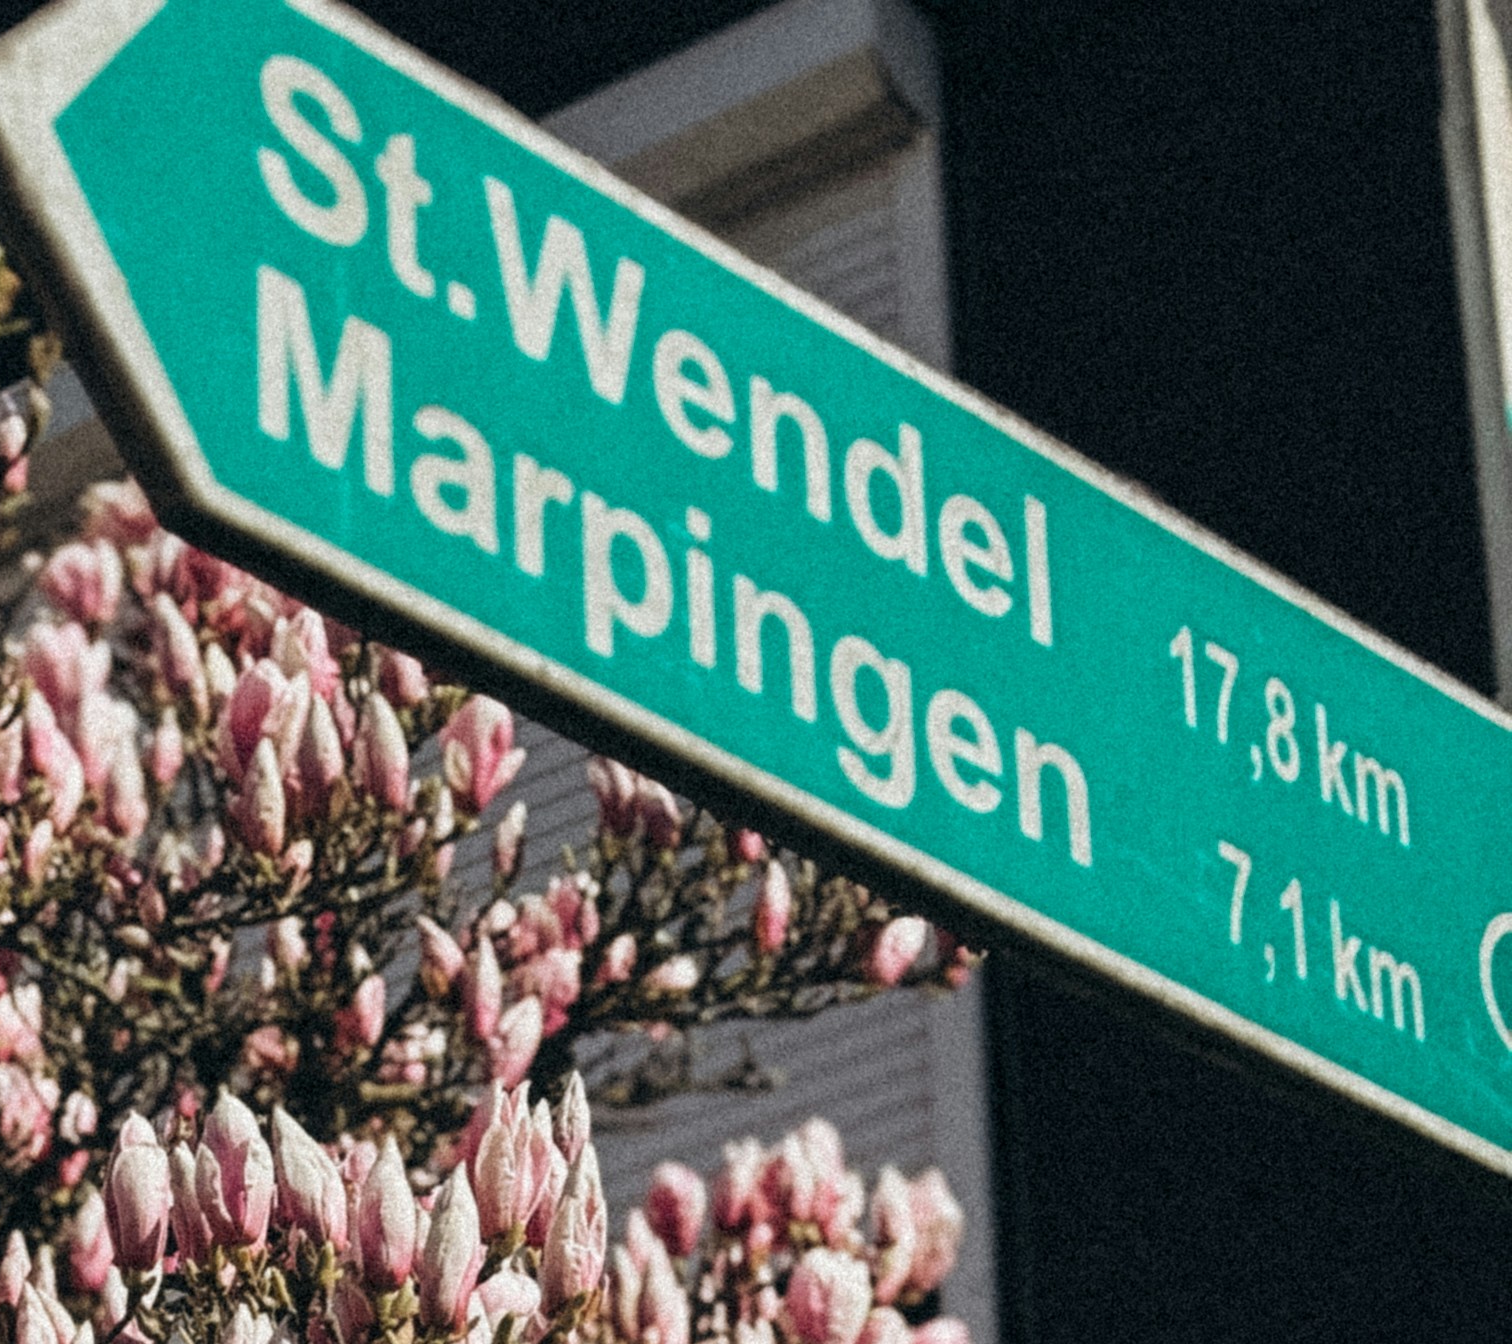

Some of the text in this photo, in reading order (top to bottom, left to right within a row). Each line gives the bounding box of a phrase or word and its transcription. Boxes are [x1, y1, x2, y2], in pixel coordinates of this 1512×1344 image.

[255, 265, 1426, 1040] Marpingen 7,1 km
[1168, 626, 1301, 783] 17,8
[1314, 702, 1411, 845] km
